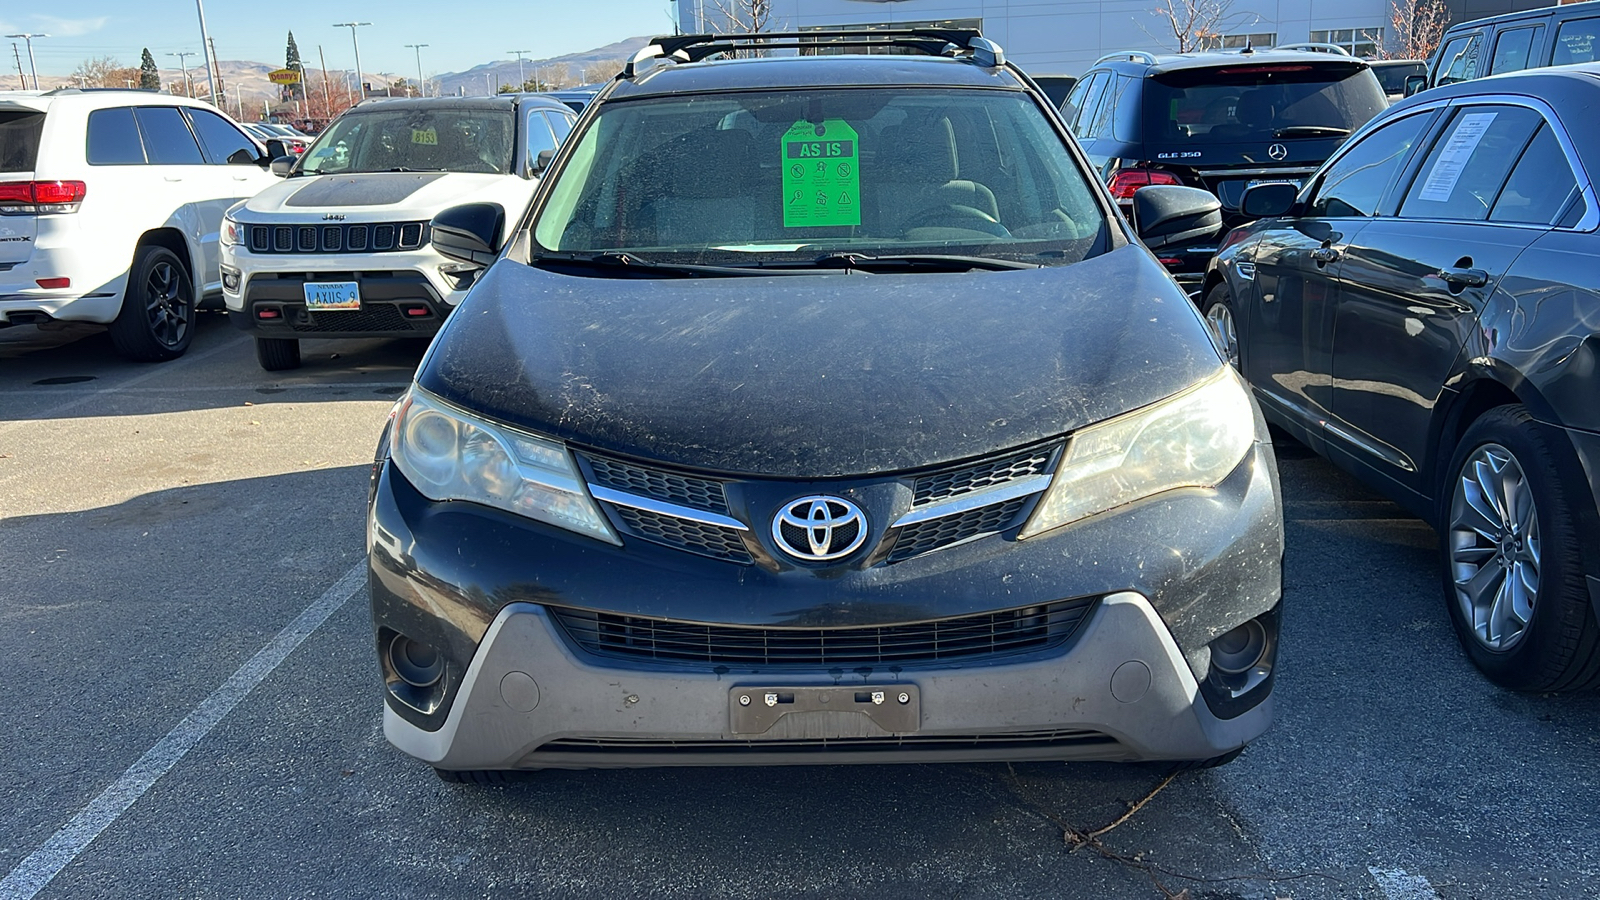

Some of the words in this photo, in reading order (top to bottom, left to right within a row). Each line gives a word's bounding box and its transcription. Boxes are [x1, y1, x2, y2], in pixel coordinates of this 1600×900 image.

[270, 72, 298, 81] Denny's
[415, 132, 435, 144] 8153
[800, 143, 821, 157] AS
[826, 142, 842, 156] IS
[322, 213, 346, 221] Jeep
